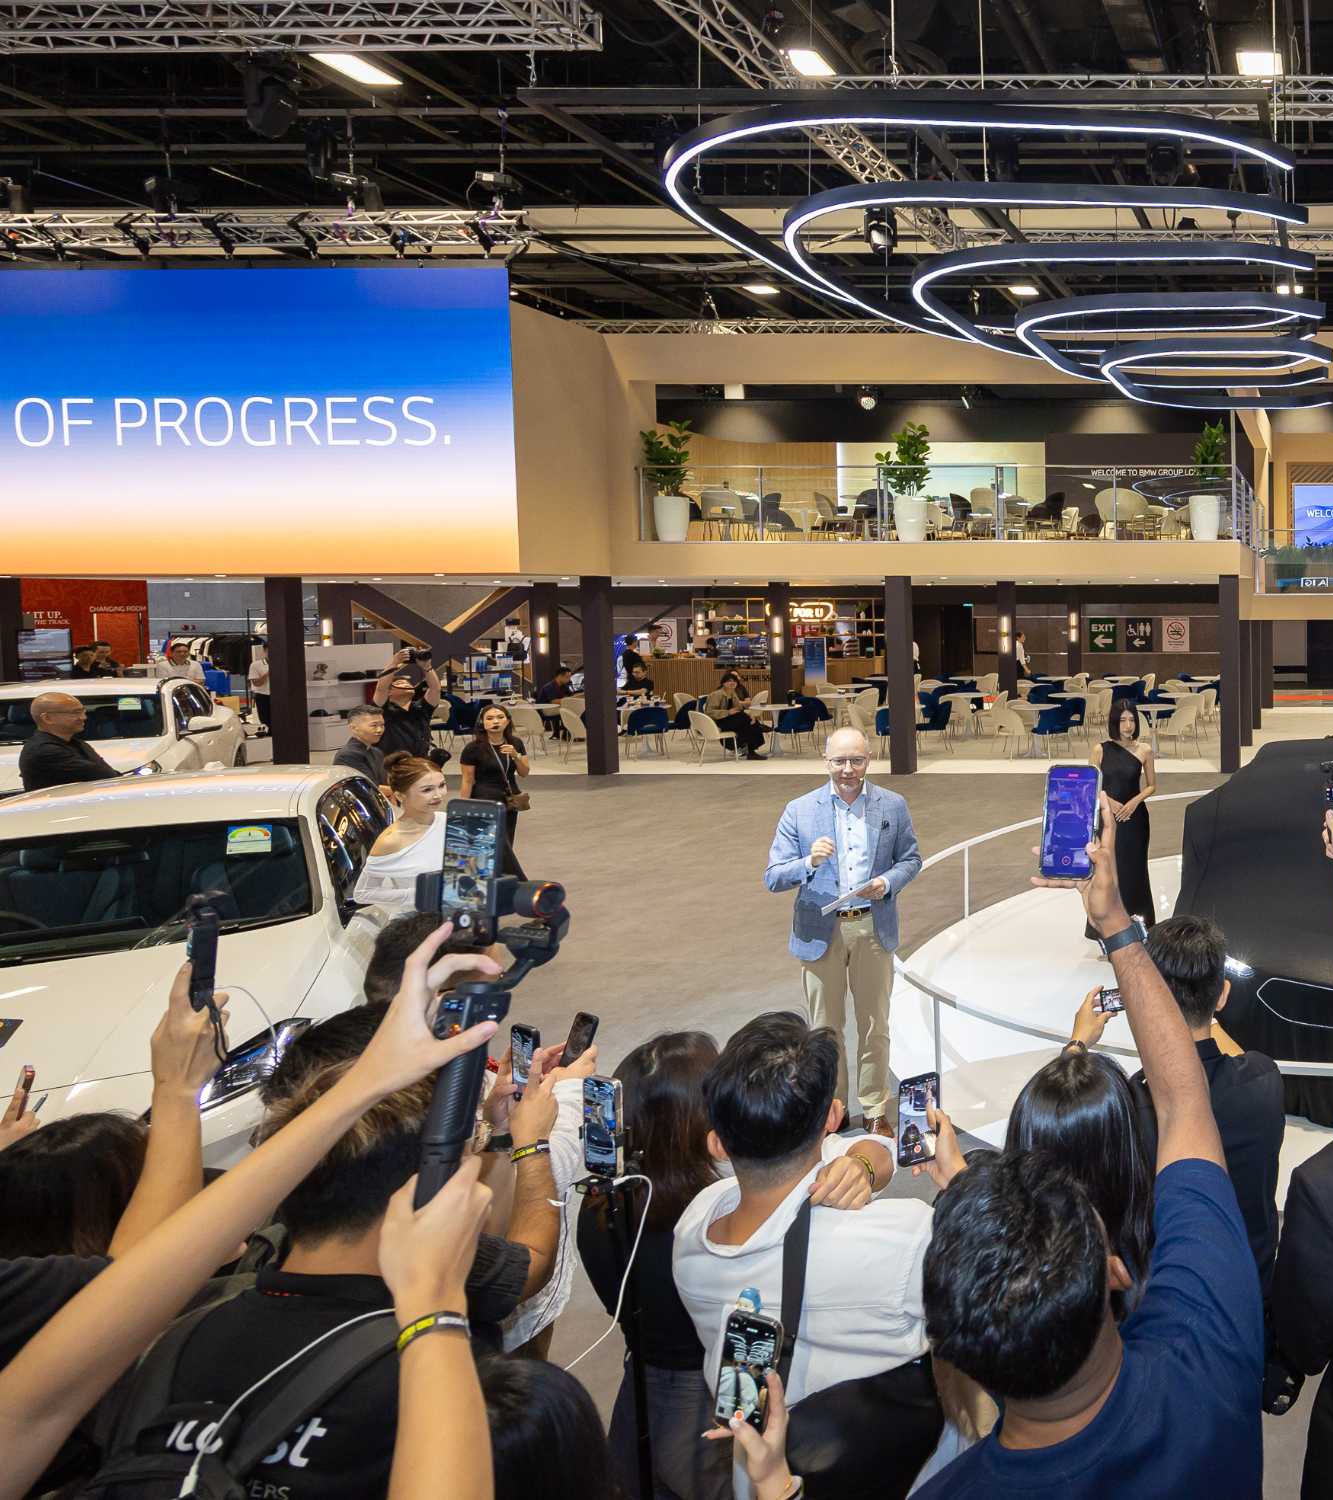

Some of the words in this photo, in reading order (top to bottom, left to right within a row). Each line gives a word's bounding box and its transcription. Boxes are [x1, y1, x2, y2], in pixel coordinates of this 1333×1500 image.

[13, 396, 94, 448] OF
[115, 396, 452, 447] PROGRESS.
[1090, 468, 1127, 477] WELCOME
[1128, 468, 1138, 477] TO
[1139, 468, 1157, 477] BMW
[1158, 468, 1183, 477] GROUP
[89, 605, 125, 613] CHANGING
[126, 605, 147, 613] ROOM
[815, 607, 824, 618] U
[33, 611, 45, 619] IT
[47, 611, 63, 619] UP.
[1091, 623, 1115, 632] EXIT
